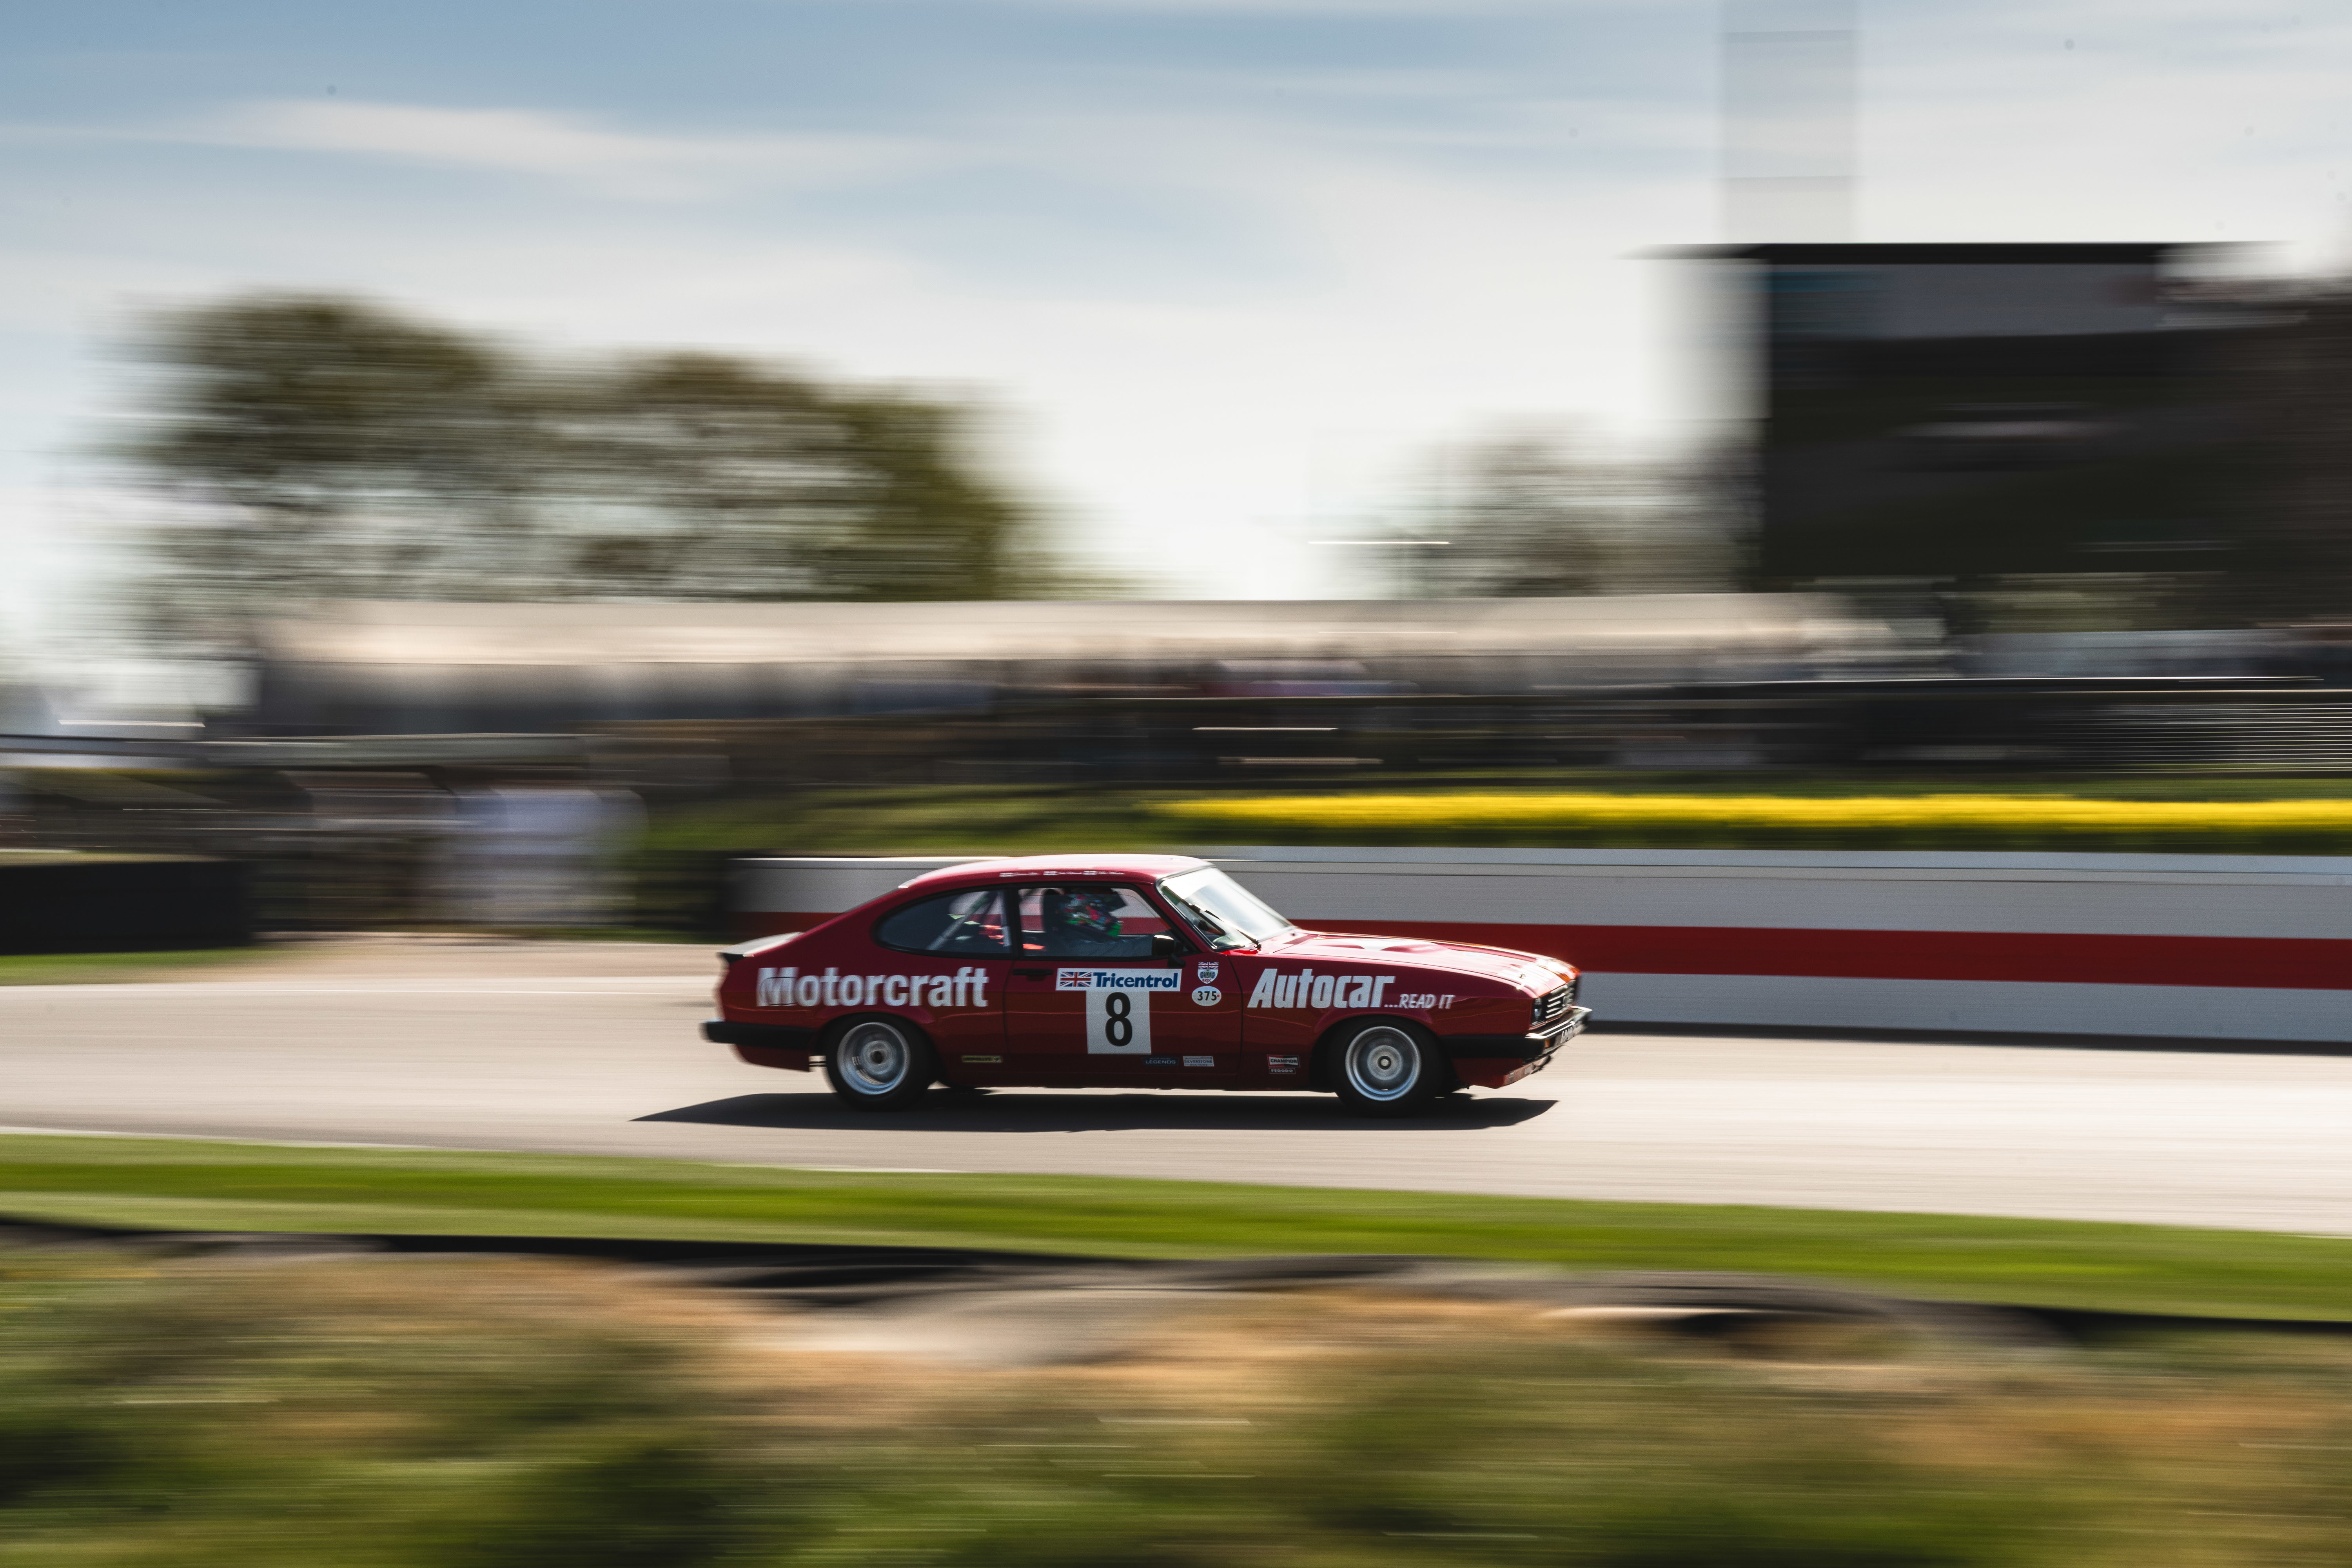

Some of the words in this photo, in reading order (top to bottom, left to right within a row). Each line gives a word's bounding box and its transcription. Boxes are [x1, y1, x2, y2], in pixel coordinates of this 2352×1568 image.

[756, 967, 989, 1007] Motorcraft
[1093, 972, 1178, 988] Tricentrol
[1198, 991, 1217, 1001] 375
[1247, 968, 1396, 1008] Autocar
[1438, 994, 1456, 1009] IT
[1105, 992, 1132, 1047] 8
